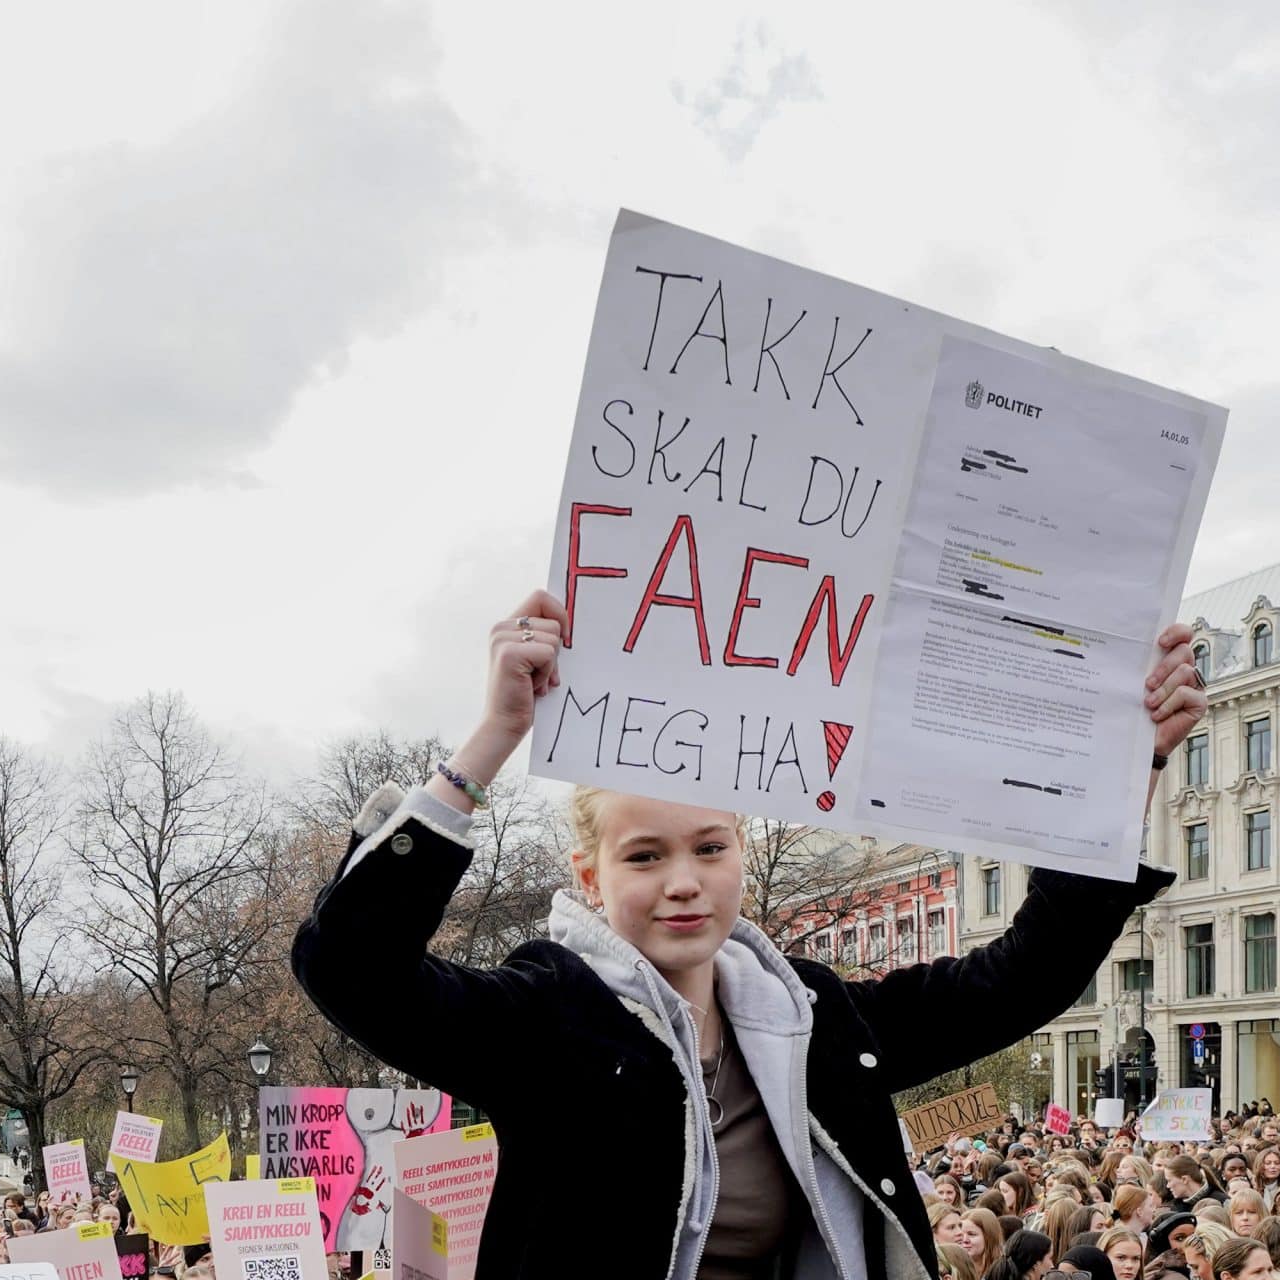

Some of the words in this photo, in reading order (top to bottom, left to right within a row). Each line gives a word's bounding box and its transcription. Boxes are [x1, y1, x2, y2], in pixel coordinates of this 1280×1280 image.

[635, 265, 873, 427] TAKK
[987, 392, 1043, 419] POLITIET
[592, 399, 766, 512] SKAL
[799, 456, 882, 538] DU
[563, 503, 874, 687] FAEN
[548, 687, 708, 782] MEG
[266, 1105, 297, 1126] MIN
[301, 1104, 344, 1122] KROPP
[1171, 1116, 1209, 1131] SEXY
[118, 1133, 154, 1153] REELL
[266, 1133, 288, 1153] ER
[295, 1129, 331, 1150] IKKE
[52, 1161, 82, 1180] REELL
[265, 1155, 355, 1179] ANSVARLIG
[403, 1168, 424, 1180] REELL
[426, 1156, 480, 1176] SAMTYKKELOV
[124, 1162, 149, 1214] 1
[157, 1194, 188, 1216] AV
[427, 1171, 482, 1191] SAMTYKKELOV
[430, 1187, 484, 1207] SAMTYKKELOV
[223, 1206, 254, 1221] KREV
[257, 1205, 272, 1217] EN
[275, 1203, 306, 1216] REELL
[224, 1222, 311, 1242] SAMTYKKELOV
